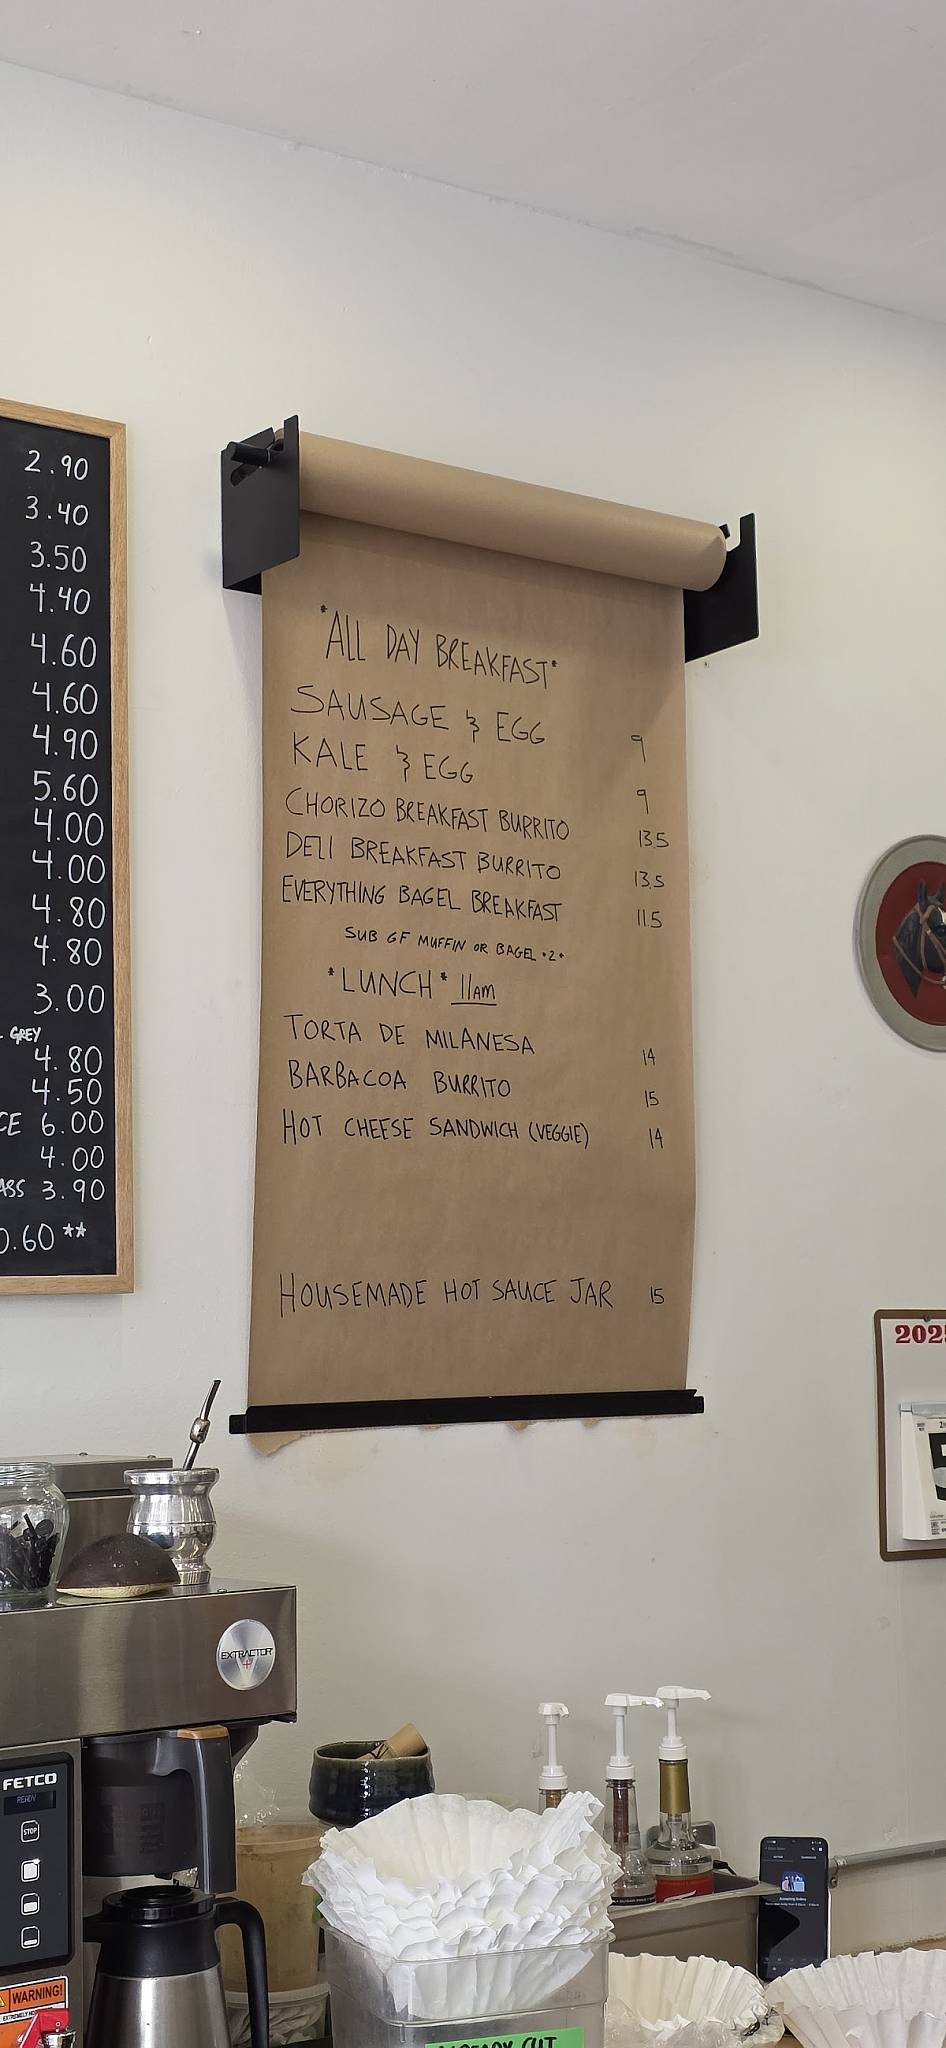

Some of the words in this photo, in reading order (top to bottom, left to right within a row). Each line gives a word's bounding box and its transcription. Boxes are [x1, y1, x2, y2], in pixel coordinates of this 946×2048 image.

[24, 449, 89, 481] 2.90
[25, 495, 89, 526] 3.40
[30, 541, 87, 573] 3.50
[29, 582, 91, 615] 4.40
[30, 632, 97, 668] 4.60
[386, 623, 420, 665] DAY
[31, 681, 99, 715] 4.60
[290, 684, 450, 731] SAUSAGE
[496, 711, 546, 745] EGG
[630, 734, 647, 764] 9
[32, 723, 98, 760] 4.90
[33, 770, 99, 807] 5.60
[293, 731, 369, 772] KALE
[423, 752, 474, 784] EGG
[636, 788, 649, 815] 9
[33, 808, 104, 847] 4.00
[285, 786, 386, 820] CHORIZO
[396, 797, 489, 833] BREAKFAST
[498, 809, 570, 841] BURRITO
[32, 849, 105, 884] 4.00
[285, 830, 333, 861] DELI
[350, 836, 467, 870] BREAKFAST
[477, 851, 561, 880] BURRITO
[32, 893, 106, 929] 4.80
[282, 874, 387, 905] EVERYTHING
[398, 884, 462, 911] BAGEL
[471, 889, 563, 923] BREAKFAST
[33, 934, 103, 967] 4.80
[344, 926, 378, 943] SUB
[386, 930, 411, 945] GF
[417, 934, 467, 953] MUFFIN
[473, 942, 489, 955] OR
[495, 942, 537, 962] BAGEL
[33, 982, 105, 1015] 3.00
[10, 1025, 42, 1045] GREY
[282, 1013, 363, 1044] TORTA
[378, 1022, 406, 1046] DE
[425, 1026, 536, 1055] MILANESA
[642, 1047, 656, 1067] 14
[34, 1044, 103, 1076] 4.80
[31, 1077, 103, 1106] 4.50
[288, 1059, 407, 1091] BARBACOA
[433, 1070, 511, 1099] BURRITO
[644, 1089, 660, 1109] 15
[41, 1109, 104, 1137] 6.00
[282, 1108, 323, 1146] HOT
[343, 1117, 414, 1141] CHEESE
[429, 1116, 520, 1140] SANDWICH
[528, 1120, 589, 1150] (VEGGIE)
[648, 1127, 664, 1150] 14
[40, 1145, 105, 1172] 4.00
[41, 1178, 106, 1203] 3.90
[279, 1272, 428, 1319] HOUSEMADE
[443, 1278, 481, 1304] HOT
[491, 1278, 558, 1304] SAUCE
[569, 1277, 614, 1310] JAR
[650, 1285, 665, 1305] 15
[894, 1324, 946, 1344] 202
[220, 1647, 273, 1660] EXTRACTOR
[3, 1772, 57, 1791] FETCO
[23, 1827, 37, 1836] STOP
[12, 1984, 63, 2004] WARNING!
